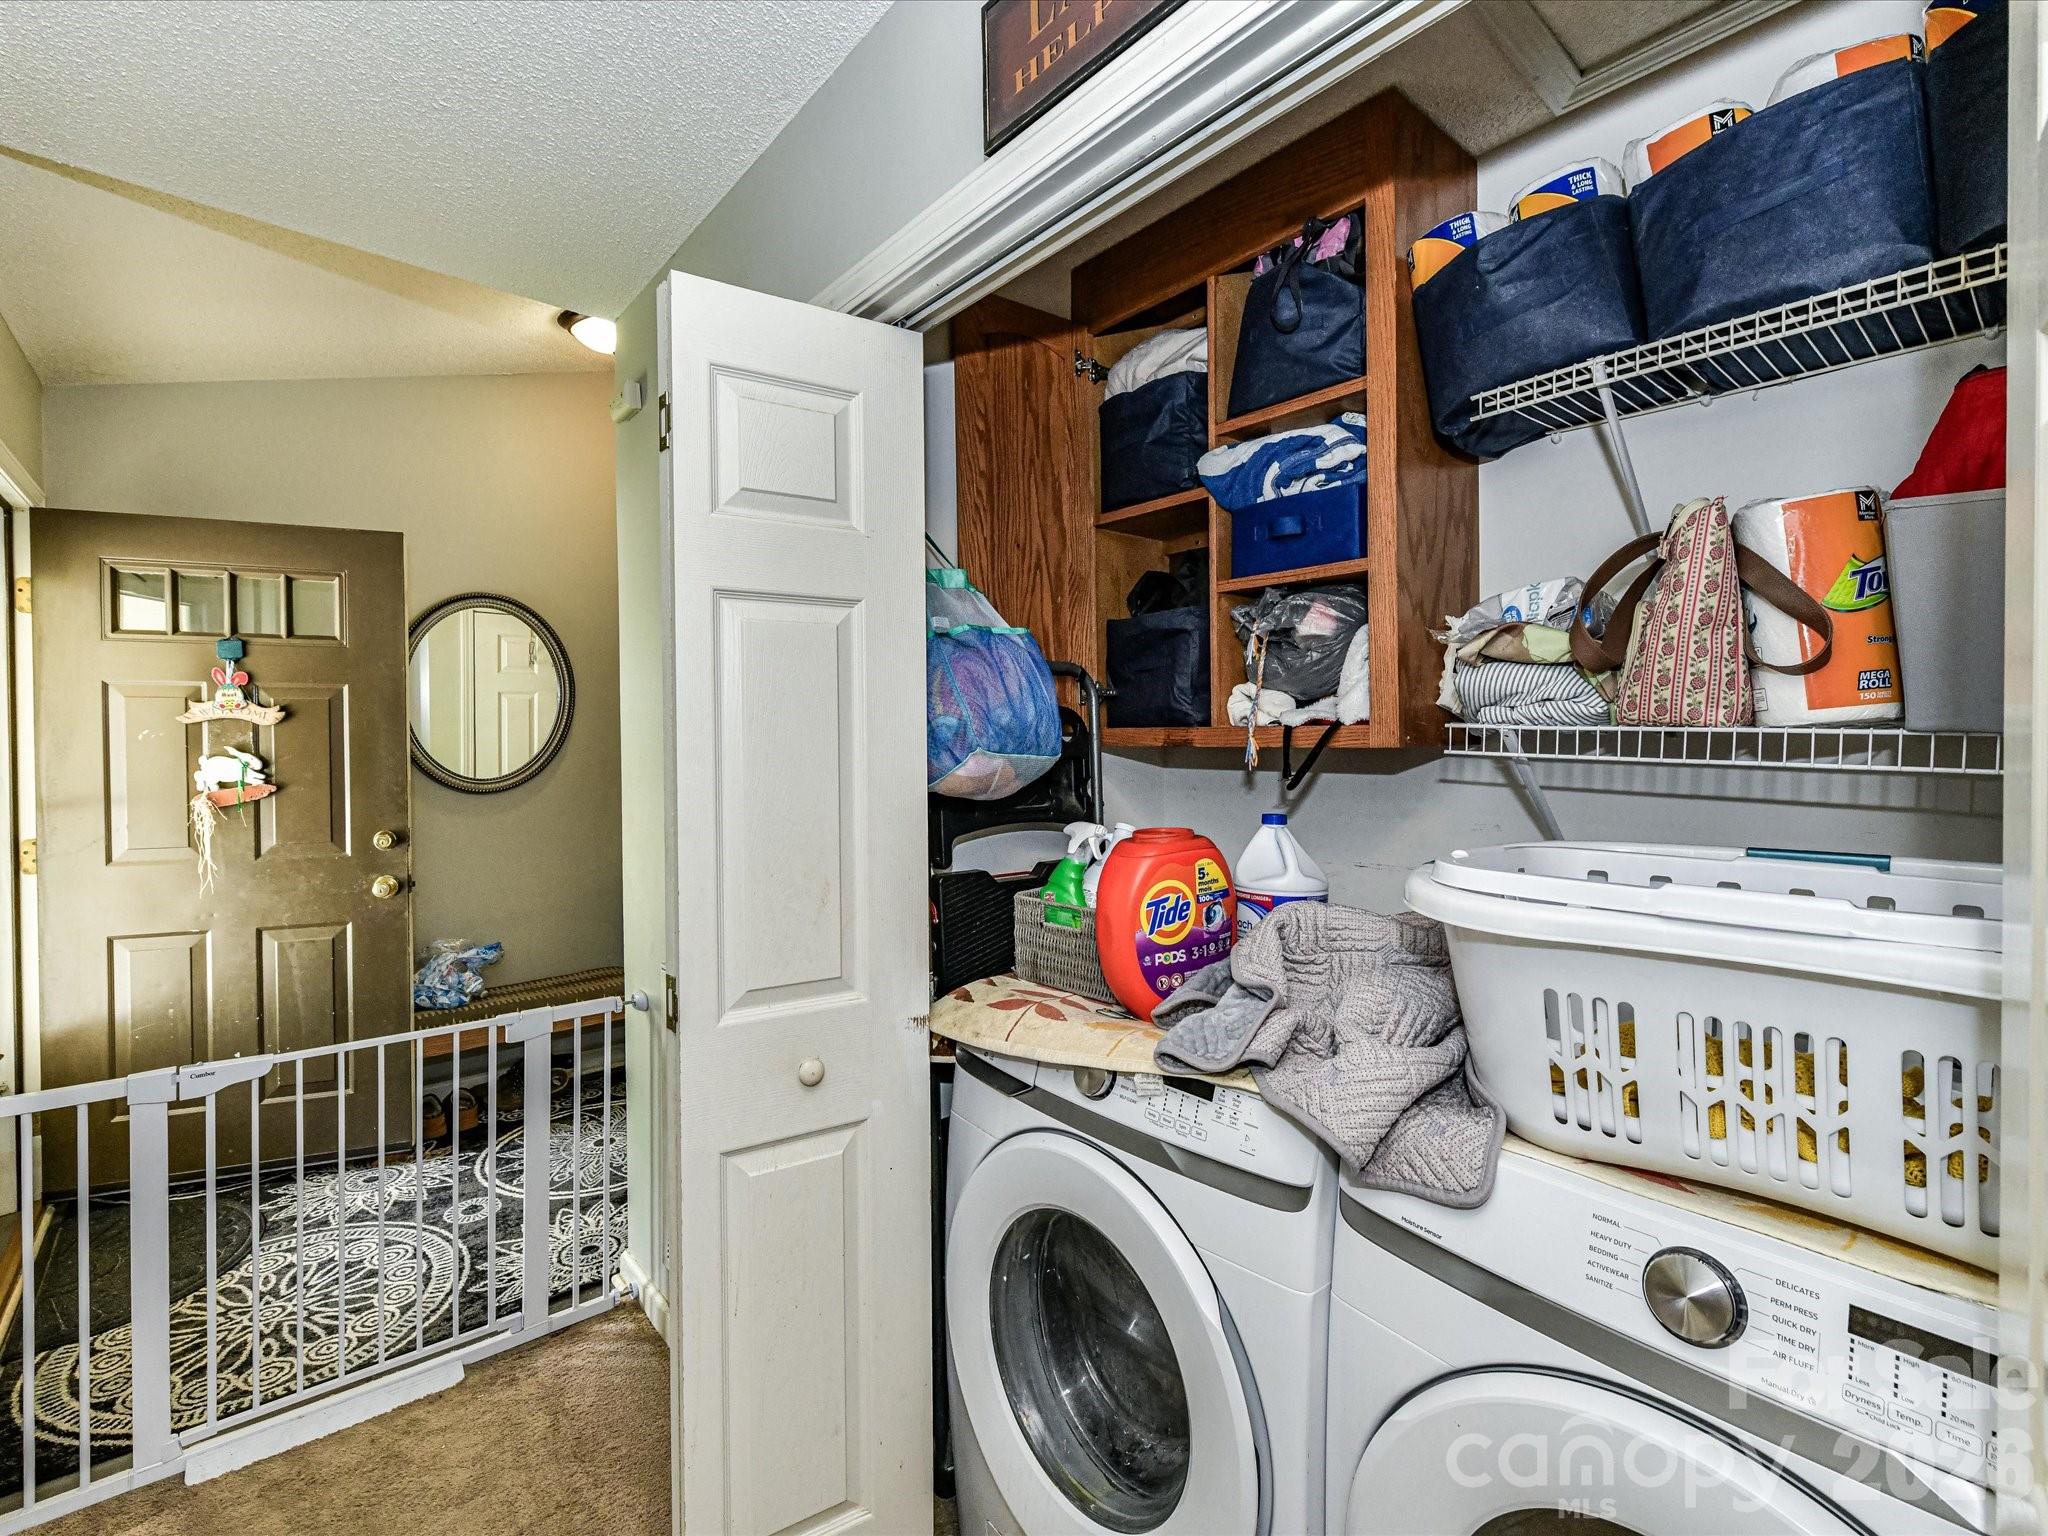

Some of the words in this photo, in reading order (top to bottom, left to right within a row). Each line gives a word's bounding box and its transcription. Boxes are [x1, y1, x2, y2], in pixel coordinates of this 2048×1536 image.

[1568, 171, 1592, 184] THICK
[1577, 179, 1593, 188] LONG
[1572, 185, 1594, 195] LASTING
[1449, 216, 1471, 229] THICK
[1457, 223, 1471, 233] LONG
[1453, 229, 1472, 240] LASTING
[1860, 670, 1890, 680] MEGA
[1859, 678, 1891, 690] ROLL
[1860, 692, 1876, 700] 150
[1198, 878, 1219, 887] months
[1145, 892, 1192, 938] Tide
[1155, 949, 1187, 966] PODS
[1401, 1216, 1424, 1230] Moisture
[1424, 1227, 1442, 1239] Sensor
[1592, 1212, 1621, 1229] NORMAL
[1590, 1230, 1613, 1243] HEAVY
[1613, 1238, 1632, 1250] DUTY
[1589, 1244, 1619, 1261] BEDDING
[1587, 1260, 1629, 1280] ACTIVEWEAR
[1585, 1273, 1614, 1290] SANITIZE
[1775, 1278, 1820, 1300] DELICATES
[1770, 1297, 1792, 1310] PERM
[1793, 1306, 1819, 1321] PRESS
[1772, 1314, 1798, 1330] QUICK
[1799, 1324, 1817, 1337] DRY
[1776, 1332, 1796, 1347] TIME
[1798, 1341, 1816, 1354] DRY
[1857, 1340, 1875, 1351] More
[1772, 1349, 1787, 1361] AIR
[1788, 1355, 1815, 1371] FLUFF
[1903, 1358, 1920, 1369] High
[1760, 1376, 1790, 1395] Manual
[1791, 1388, 1805, 1401] Dry
[1855, 1377, 1870, 1388] Less
[1844, 1389, 1881, 1411] Dryness
[1869, 1414, 1886, 1425] Child
[1896, 1409, 1923, 1428] Temp.
[1950, 1414, 1959, 1423] 20
[1959, 1417, 1975, 1429] min
[1946, 1430, 1971, 1447] Time
